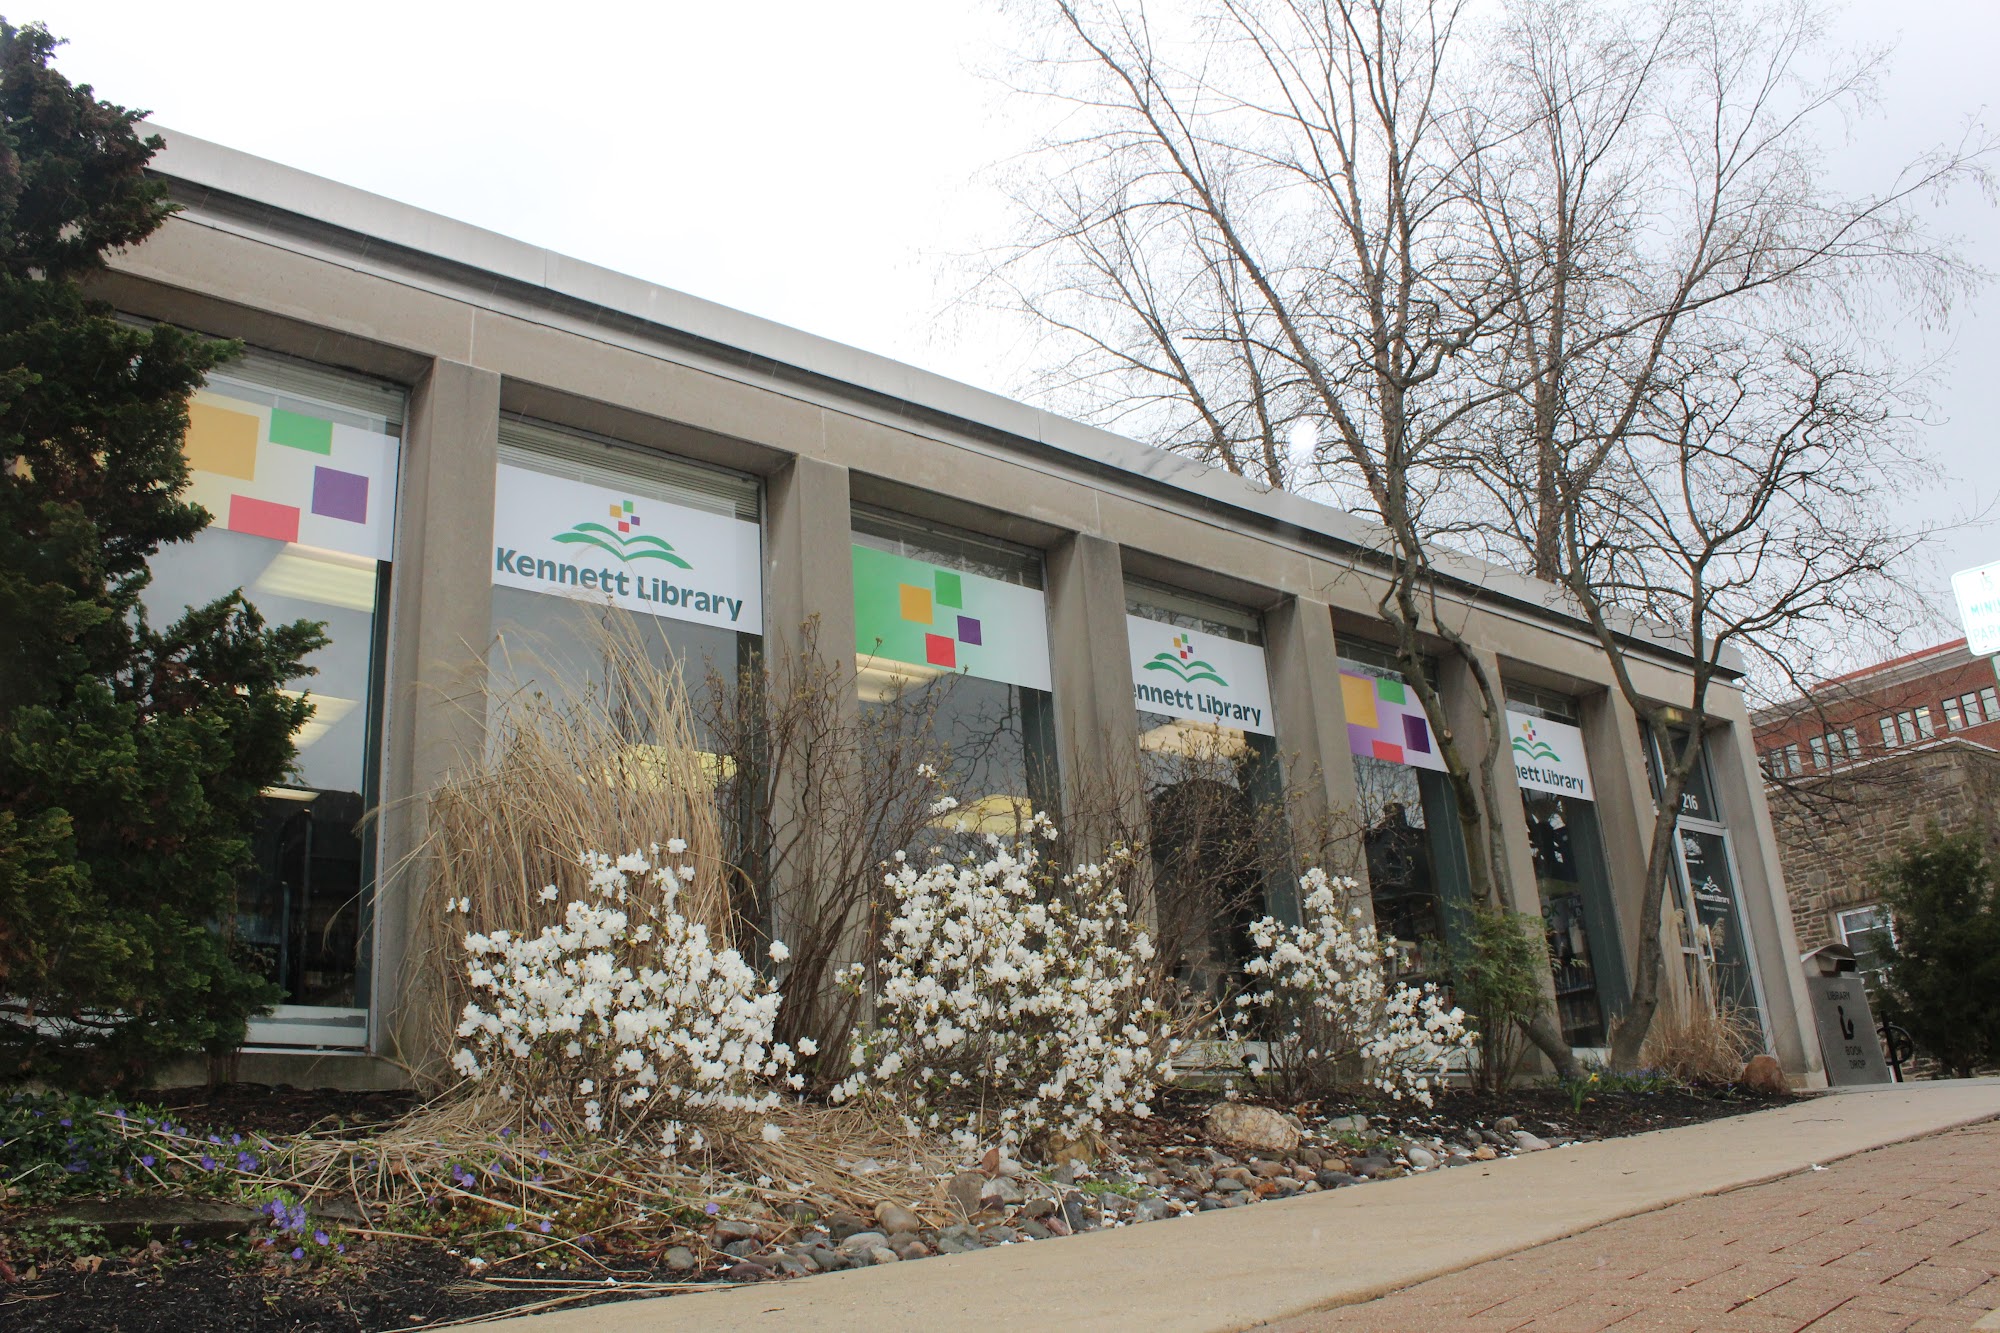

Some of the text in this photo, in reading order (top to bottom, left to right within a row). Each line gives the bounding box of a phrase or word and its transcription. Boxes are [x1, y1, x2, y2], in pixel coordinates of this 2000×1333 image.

[497, 547, 743, 622] Kennett Library
[1197, 693, 1261, 727] Library
[1542, 768, 1584, 793] Library
[1681, 792, 1698, 811] 216
[1826, 990, 1851, 1001] LIBRARY
[1845, 1046, 1863, 1056] BOOK
[1849, 1060, 1866, 1070] DROP
